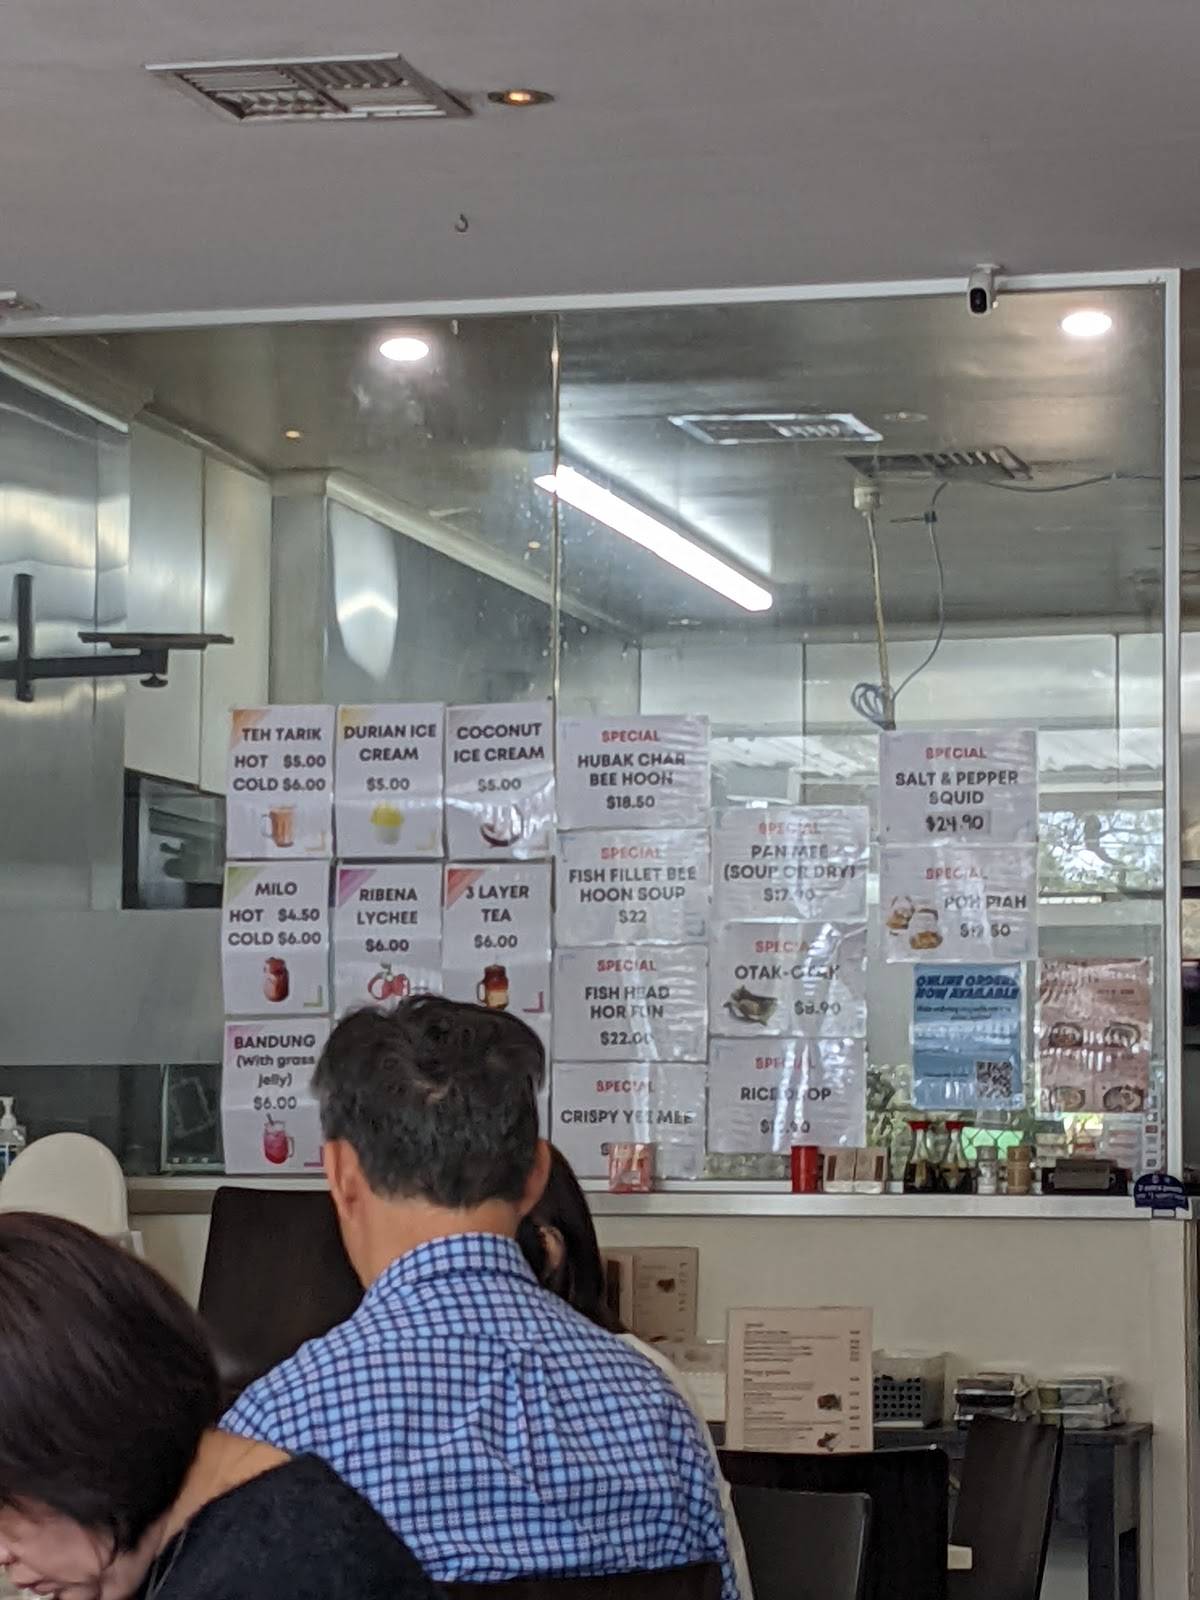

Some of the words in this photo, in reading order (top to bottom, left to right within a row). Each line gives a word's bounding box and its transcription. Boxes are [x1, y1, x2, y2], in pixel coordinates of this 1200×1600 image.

[242, 728, 271, 741] TEH
[276, 727, 322, 741] TARIK
[344, 726, 408, 739] DURIAN
[411, 724, 437, 737] ICE
[457, 723, 542, 739] COCONUT
[601, 730, 661, 743] SPECIAL
[360, 748, 419, 761] CREAM
[454, 749, 480, 762] ICE
[484, 746, 544, 761] CREAM
[577, 753, 634, 768] HUBAK
[638, 752, 686, 766] CHAR
[925, 747, 987, 759] SPECIAL
[234, 755, 268, 768] HOT
[283, 754, 326, 768] $5.00
[233, 778, 278, 791] COLD
[282, 778, 326, 791] $6.00
[366, 778, 410, 791] $5.00
[478, 778, 522, 791] $5.00
[590, 773, 617, 786] BEE
[622, 772, 673, 786] HOON
[895, 772, 936, 786] SALT
[941, 772, 952, 785] &
[956, 771, 1018, 785] PEPPER
[606, 795, 655, 810] $18.50
[929, 791, 984, 805] SQUID
[925, 814, 984, 832] $24.90
[601, 847, 661, 860] SPECIAL
[569, 868, 605, 883] FISH
[610, 867, 662, 882] FILLET
[667, 866, 697, 880] BEE
[255, 882, 297, 896] MILO
[359, 888, 418, 901] RIBENA
[465, 886, 475, 899] 3
[479, 885, 529, 899] LAYER
[580, 887, 633, 903] HOON
[638, 886, 686, 901] SOUP
[229, 909, 264, 922] HOT
[277, 908, 320, 922] $4.50
[357, 911, 418, 925] LYCHEE
[481, 909, 512, 922] TEA
[618, 910, 647, 924] $22
[228, 933, 274, 946] COLD
[278, 932, 321, 945] $6.00
[365, 939, 409, 952] $6.00
[474, 935, 518, 949] $6.00
[597, 959, 657, 973] SPECIAL
[585, 986, 620, 1000] FISH
[590, 1005, 626, 1020] HOR
[234, 1034, 316, 1050] BANDUNG
[253, 1096, 297, 1110] $6.00
[561, 1110, 618, 1124] CRISPY
